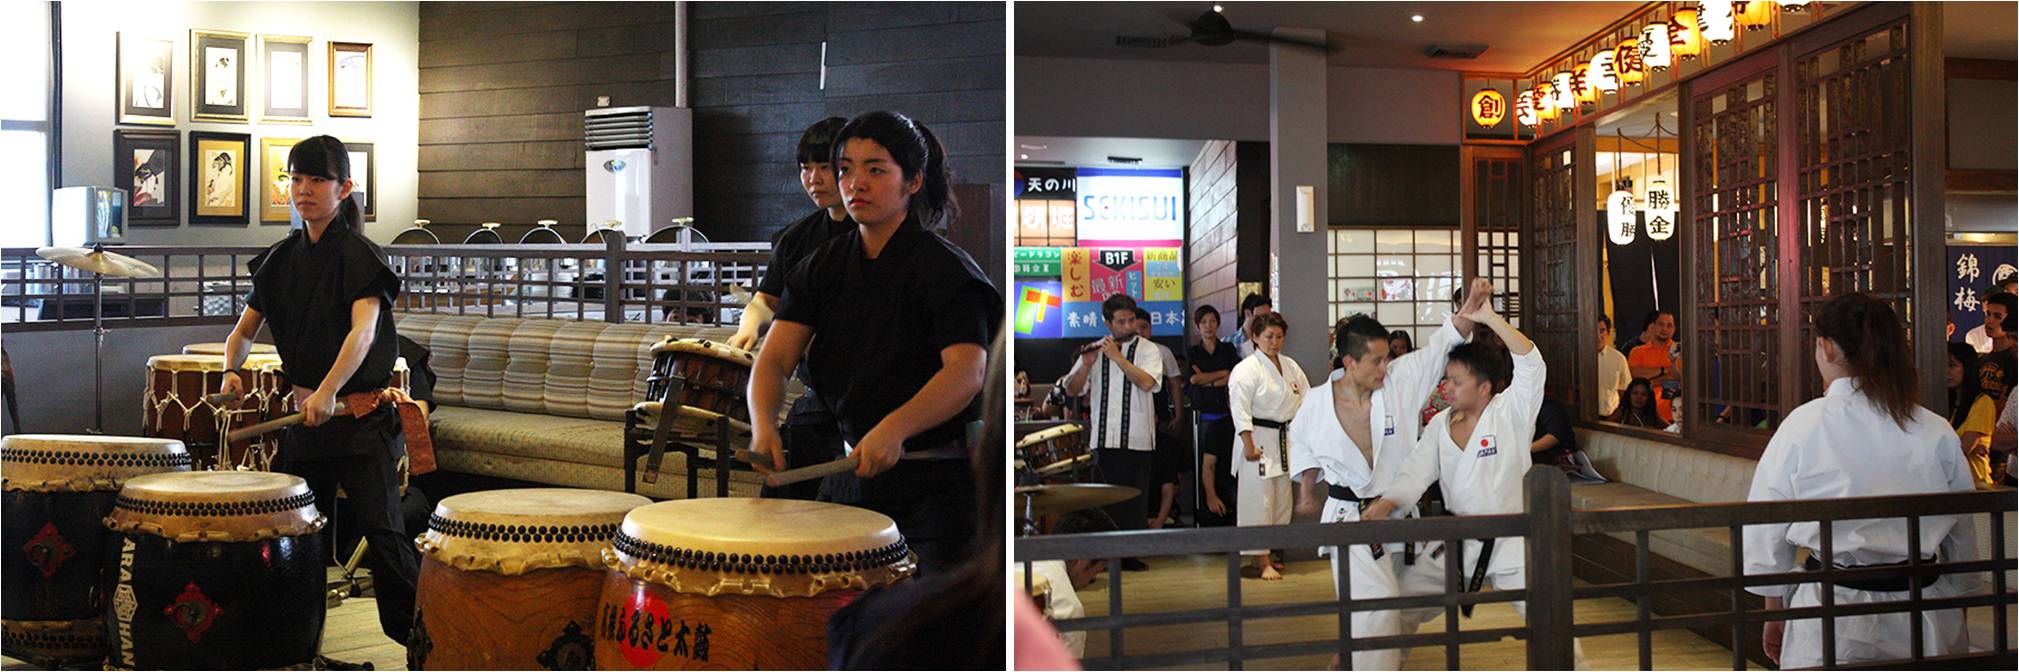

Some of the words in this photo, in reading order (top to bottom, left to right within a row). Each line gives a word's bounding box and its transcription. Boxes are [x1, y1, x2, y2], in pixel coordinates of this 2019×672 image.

[1478, 95, 1501, 119] 創
[1028, 178, 1076, 193] 天の川
[1084, 195, 1176, 221] SEKISUI
[1105, 252, 1128, 265] B1F
[1954, 253, 1981, 312] 錦梅
